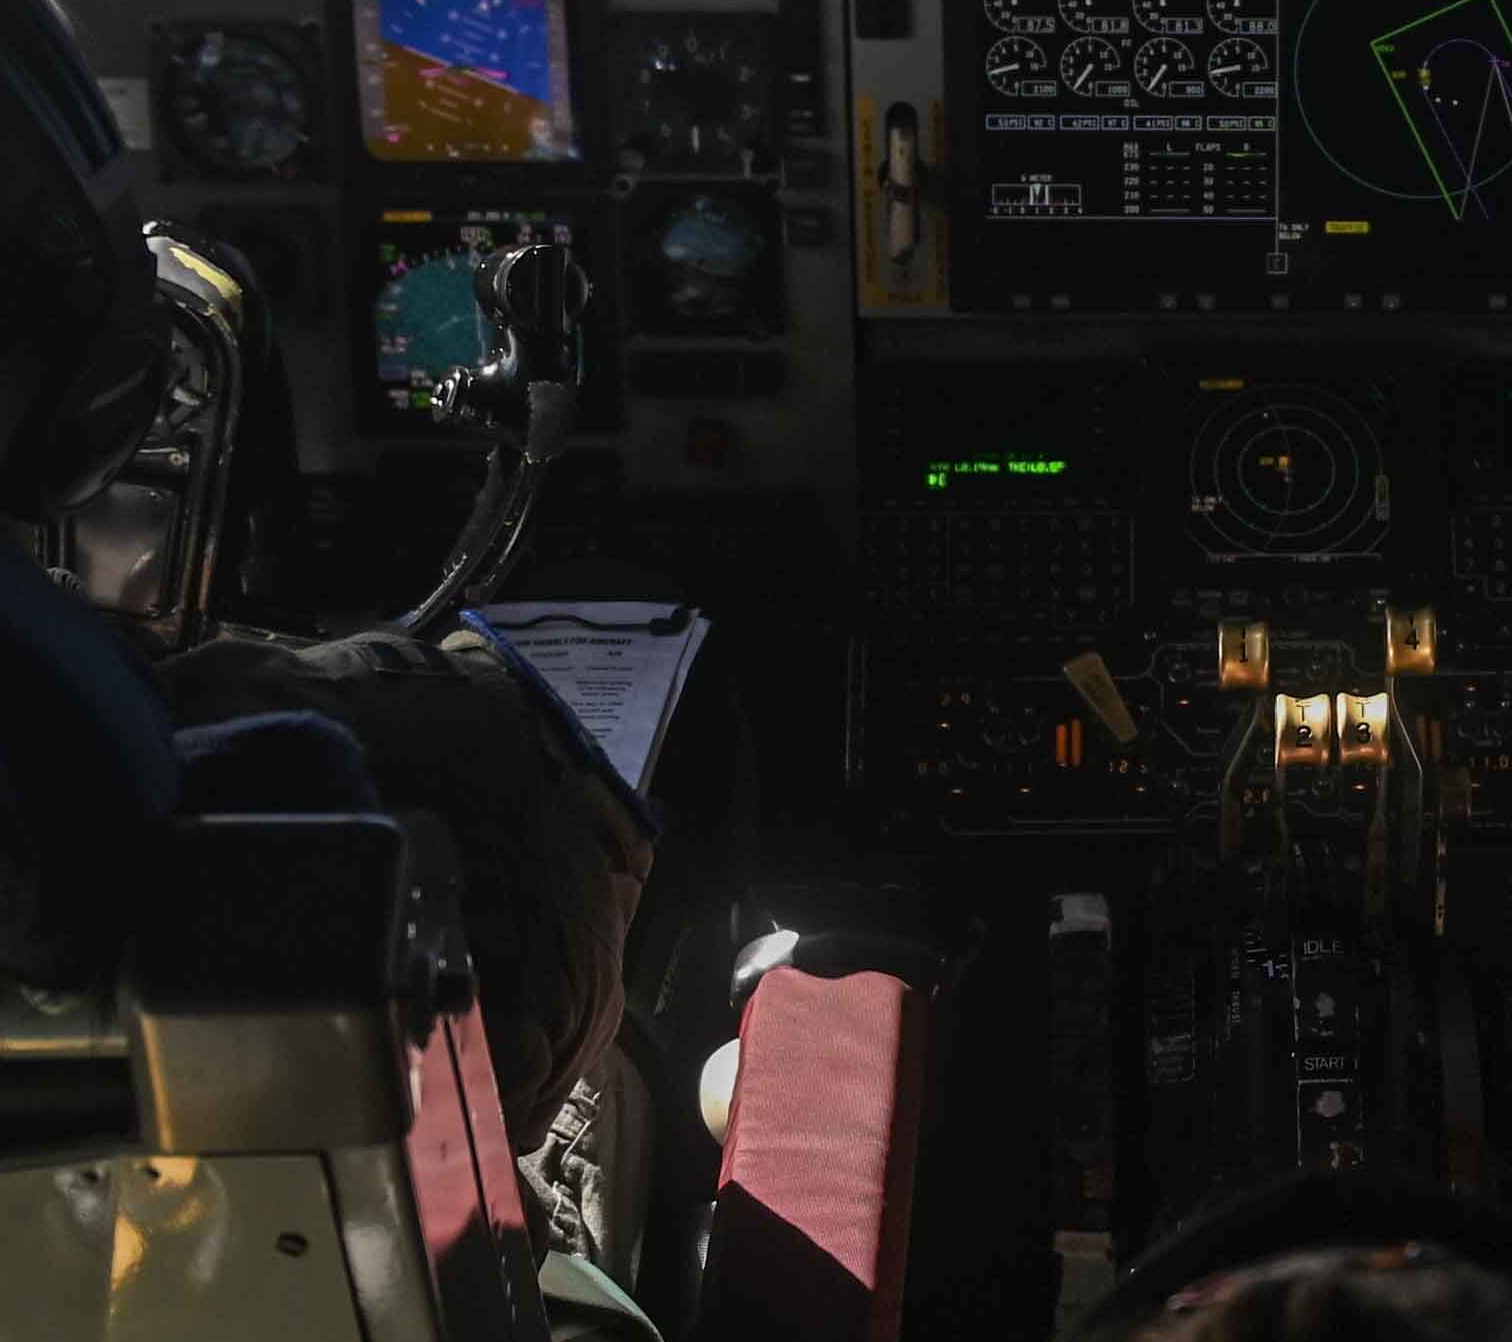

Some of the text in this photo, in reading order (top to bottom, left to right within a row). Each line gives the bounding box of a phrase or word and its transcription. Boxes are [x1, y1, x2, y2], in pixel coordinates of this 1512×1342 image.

[1195, 142, 1222, 153] FLAPS
[1405, 630, 1421, 652] 4
[1295, 721, 1373, 748] 2 3
[1303, 937, 1346, 956] IDLE
[1303, 1056, 1346, 1071] START
